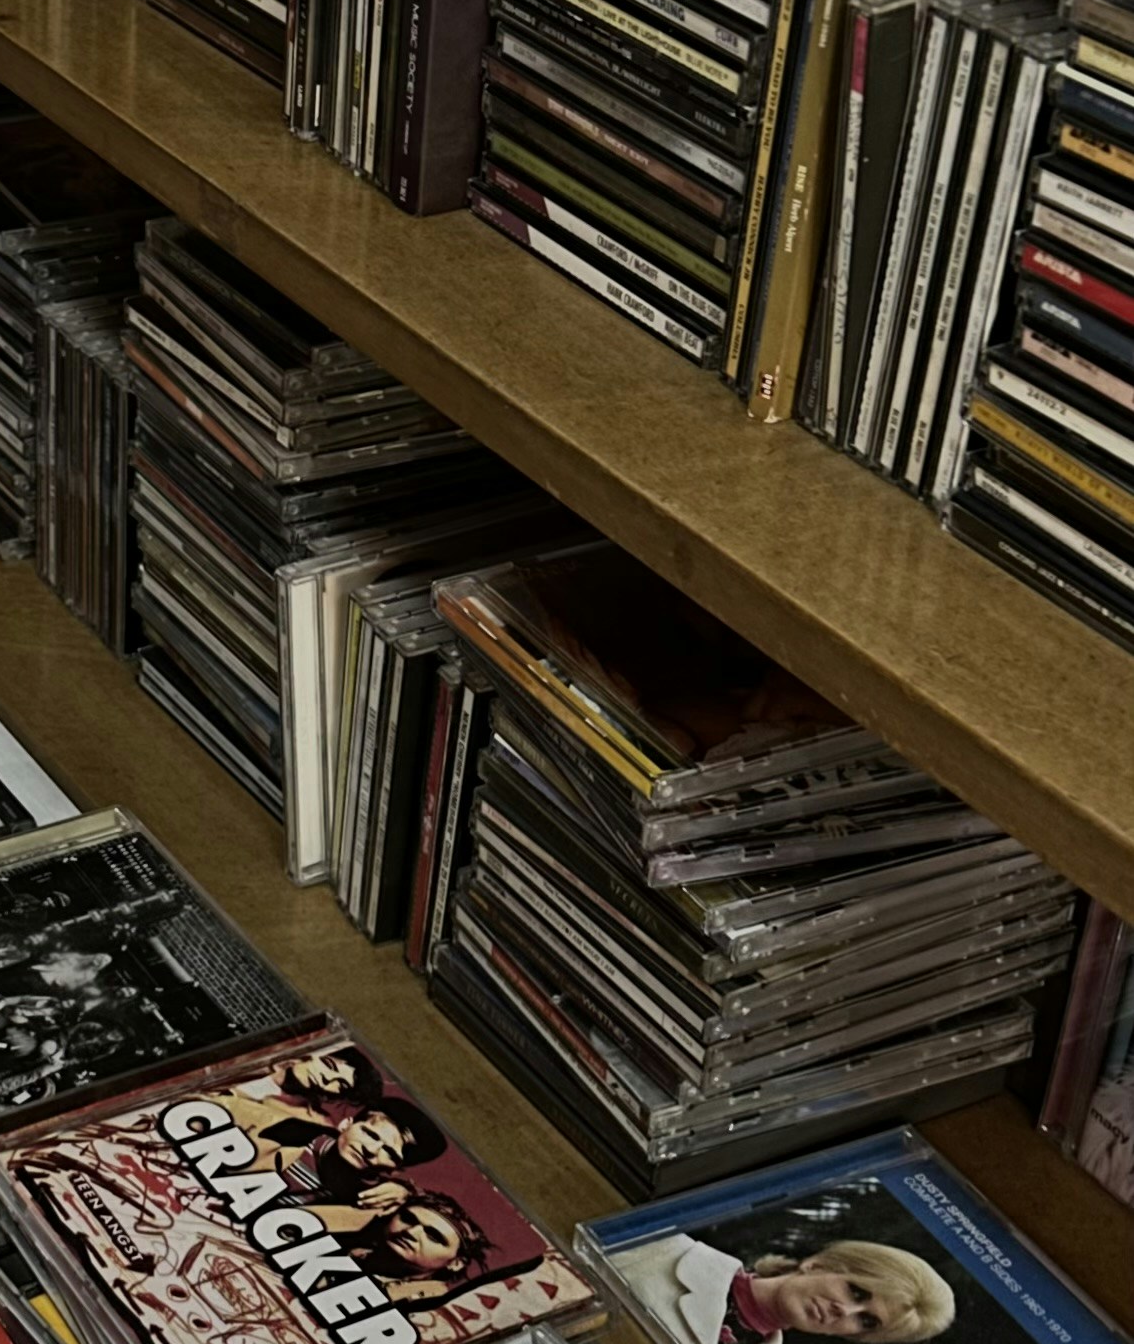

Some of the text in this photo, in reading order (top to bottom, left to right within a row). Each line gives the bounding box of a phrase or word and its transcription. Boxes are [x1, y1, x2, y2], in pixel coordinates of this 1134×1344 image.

[407, 2, 420, 48] MUSIC
[403, 50, 417, 113] SOCIETY
[761, 47, 784, 151] IT HAD TO BE YOU
[751, 173, 765, 214] HARRY
[782, 165, 807, 258] RISE Herb Alpert
[1054, 176, 1125, 222] KEITH JARRETT
[743, 215, 758, 267] CONNICK
[1030, 248, 1087, 287] ARISTA
[602, 281, 626, 302] HANK
[619, 293, 658, 324] CRAWFORD
[661, 319, 684, 340] NIGHT
[729, 302, 745, 360] COLUMBIA
[1038, 299, 1086, 330] ARISTA
[71, 1173, 144, 1266] TEEN ANGST
[910, 1170, 1014, 1270] DUSTY SPRINGFIELD
